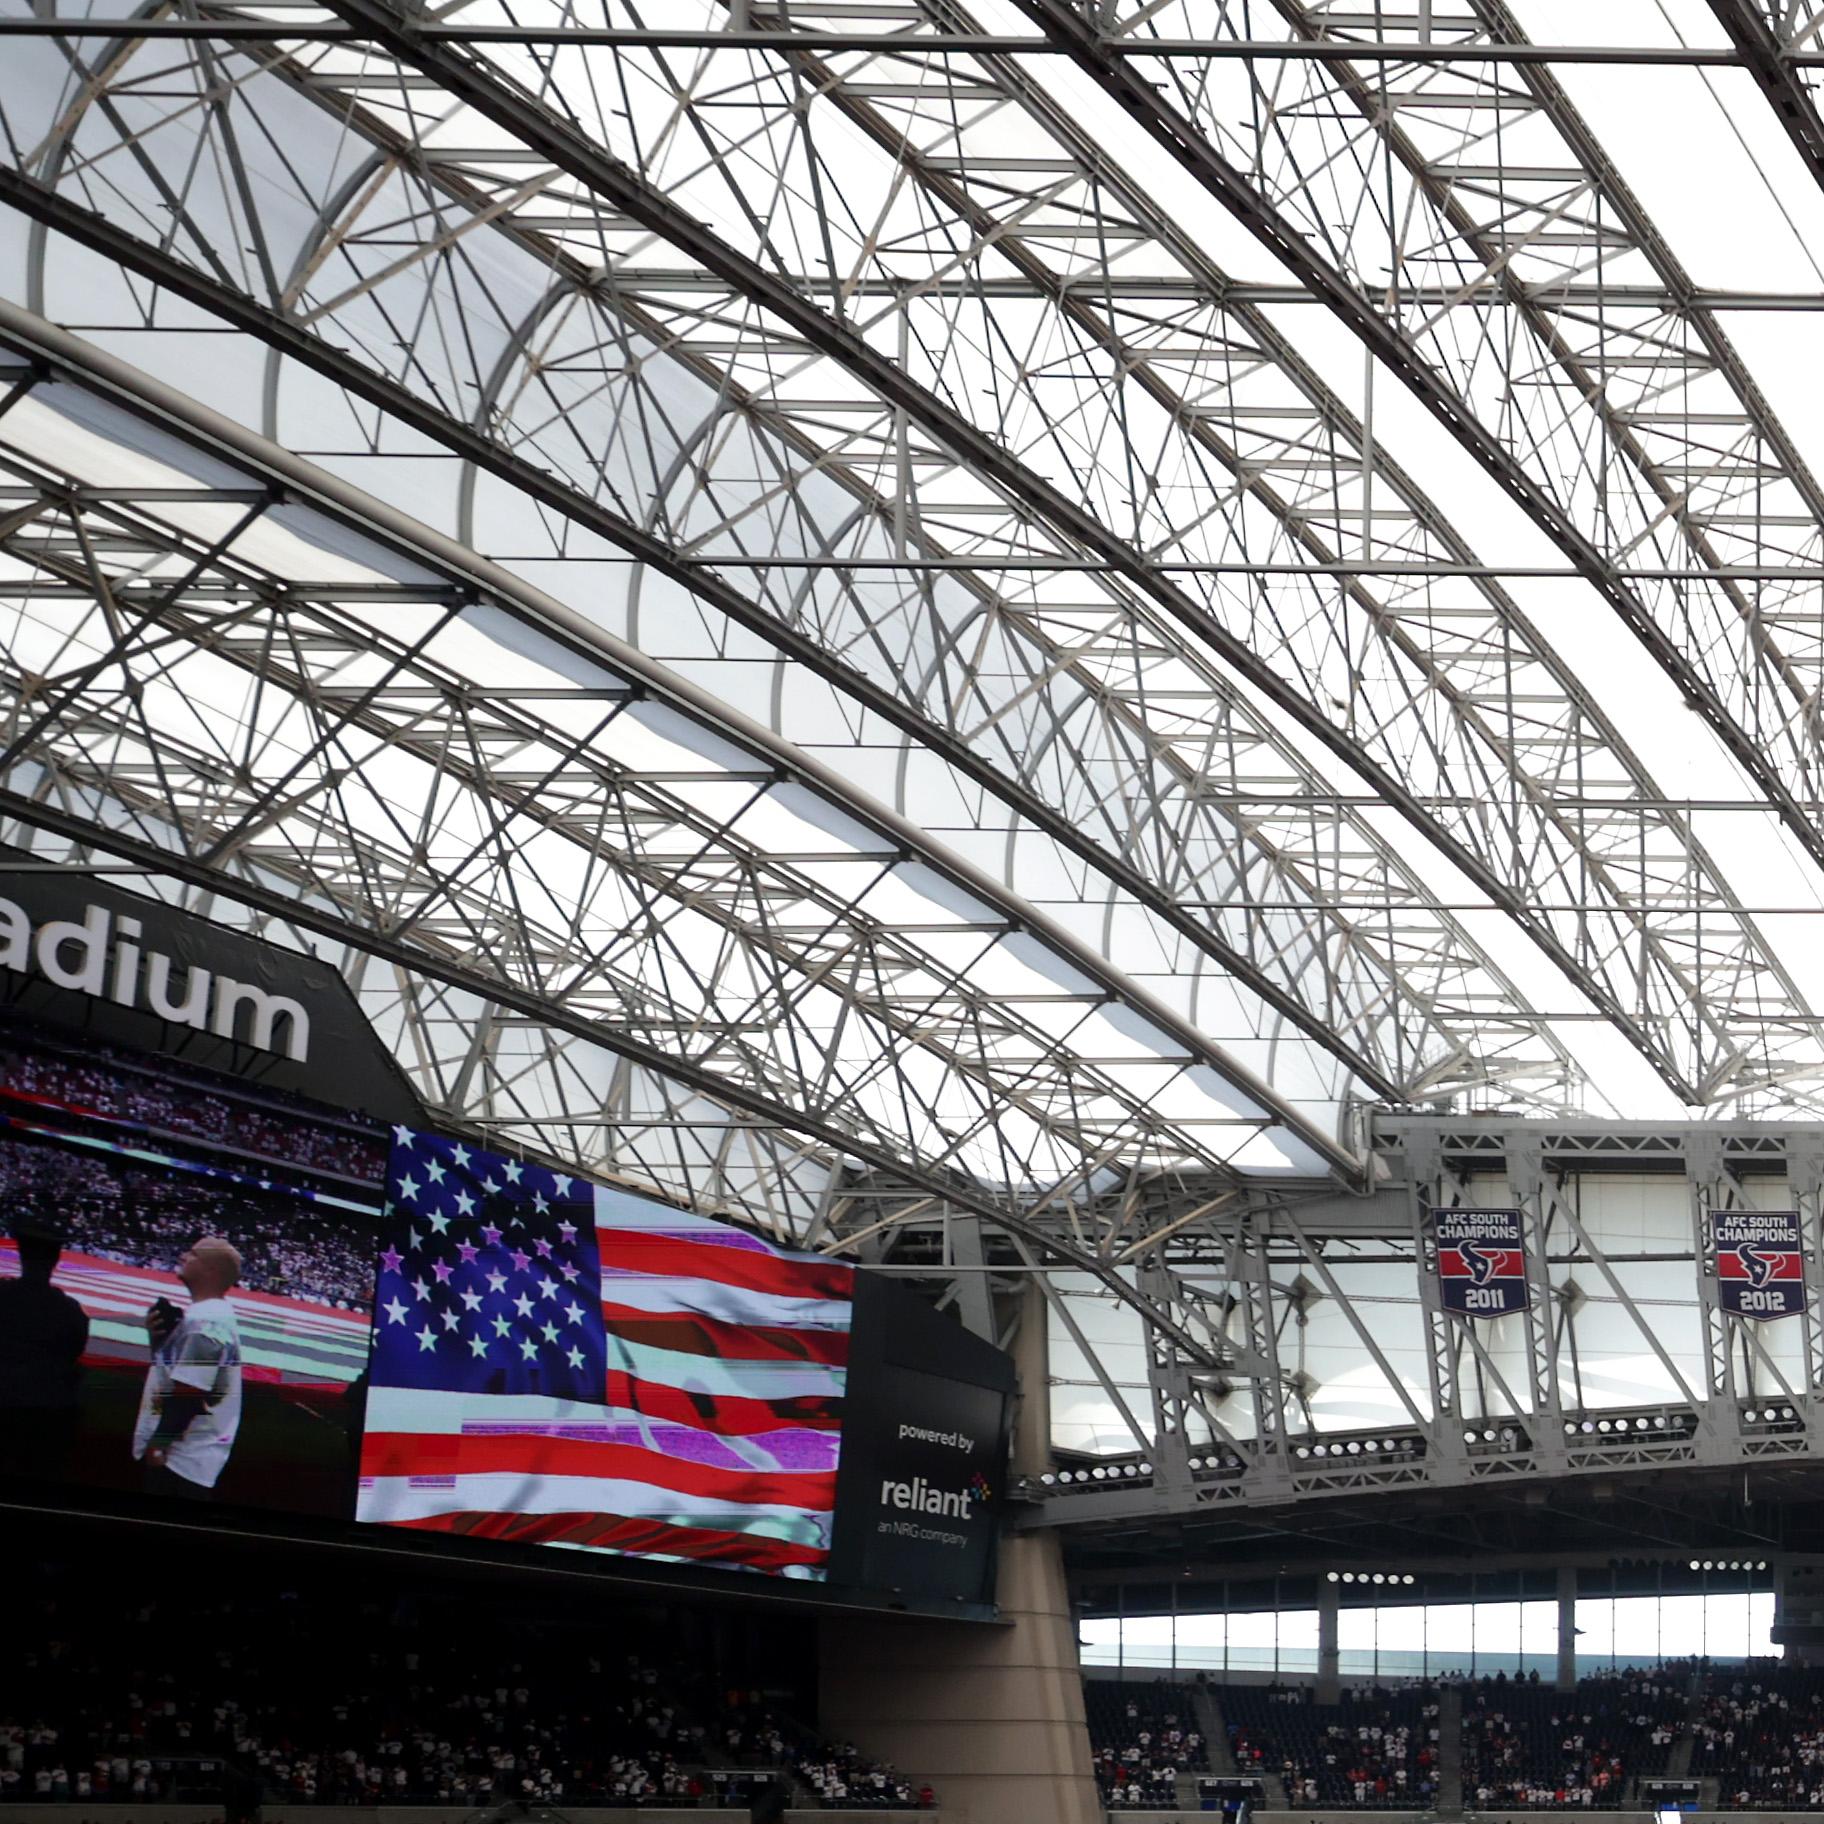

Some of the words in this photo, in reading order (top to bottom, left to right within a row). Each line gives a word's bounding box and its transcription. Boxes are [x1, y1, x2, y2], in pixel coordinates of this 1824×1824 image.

[1445, 1214, 1468, 1224] AFC
[1470, 1214, 1508, 1224] SOUTH
[1725, 1217, 1747, 1227] AFC
[1749, 1217, 1787, 1227] SOUTH
[1437, 1225, 1518, 1239] CHAMPIONS
[1717, 1228, 1797, 1241] CHAMPIONS
[1465, 1289, 1505, 1308] 2011
[1740, 1291, 1785, 1311] 2012
[899, 1424, 957, 1447] powered
[958, 1434, 975, 1453] by
[881, 1477, 972, 1519] reliant
[878, 1521, 891, 1533] an
[893, 1522, 919, 1538] NRG
[920, 1528, 968, 1548] company
